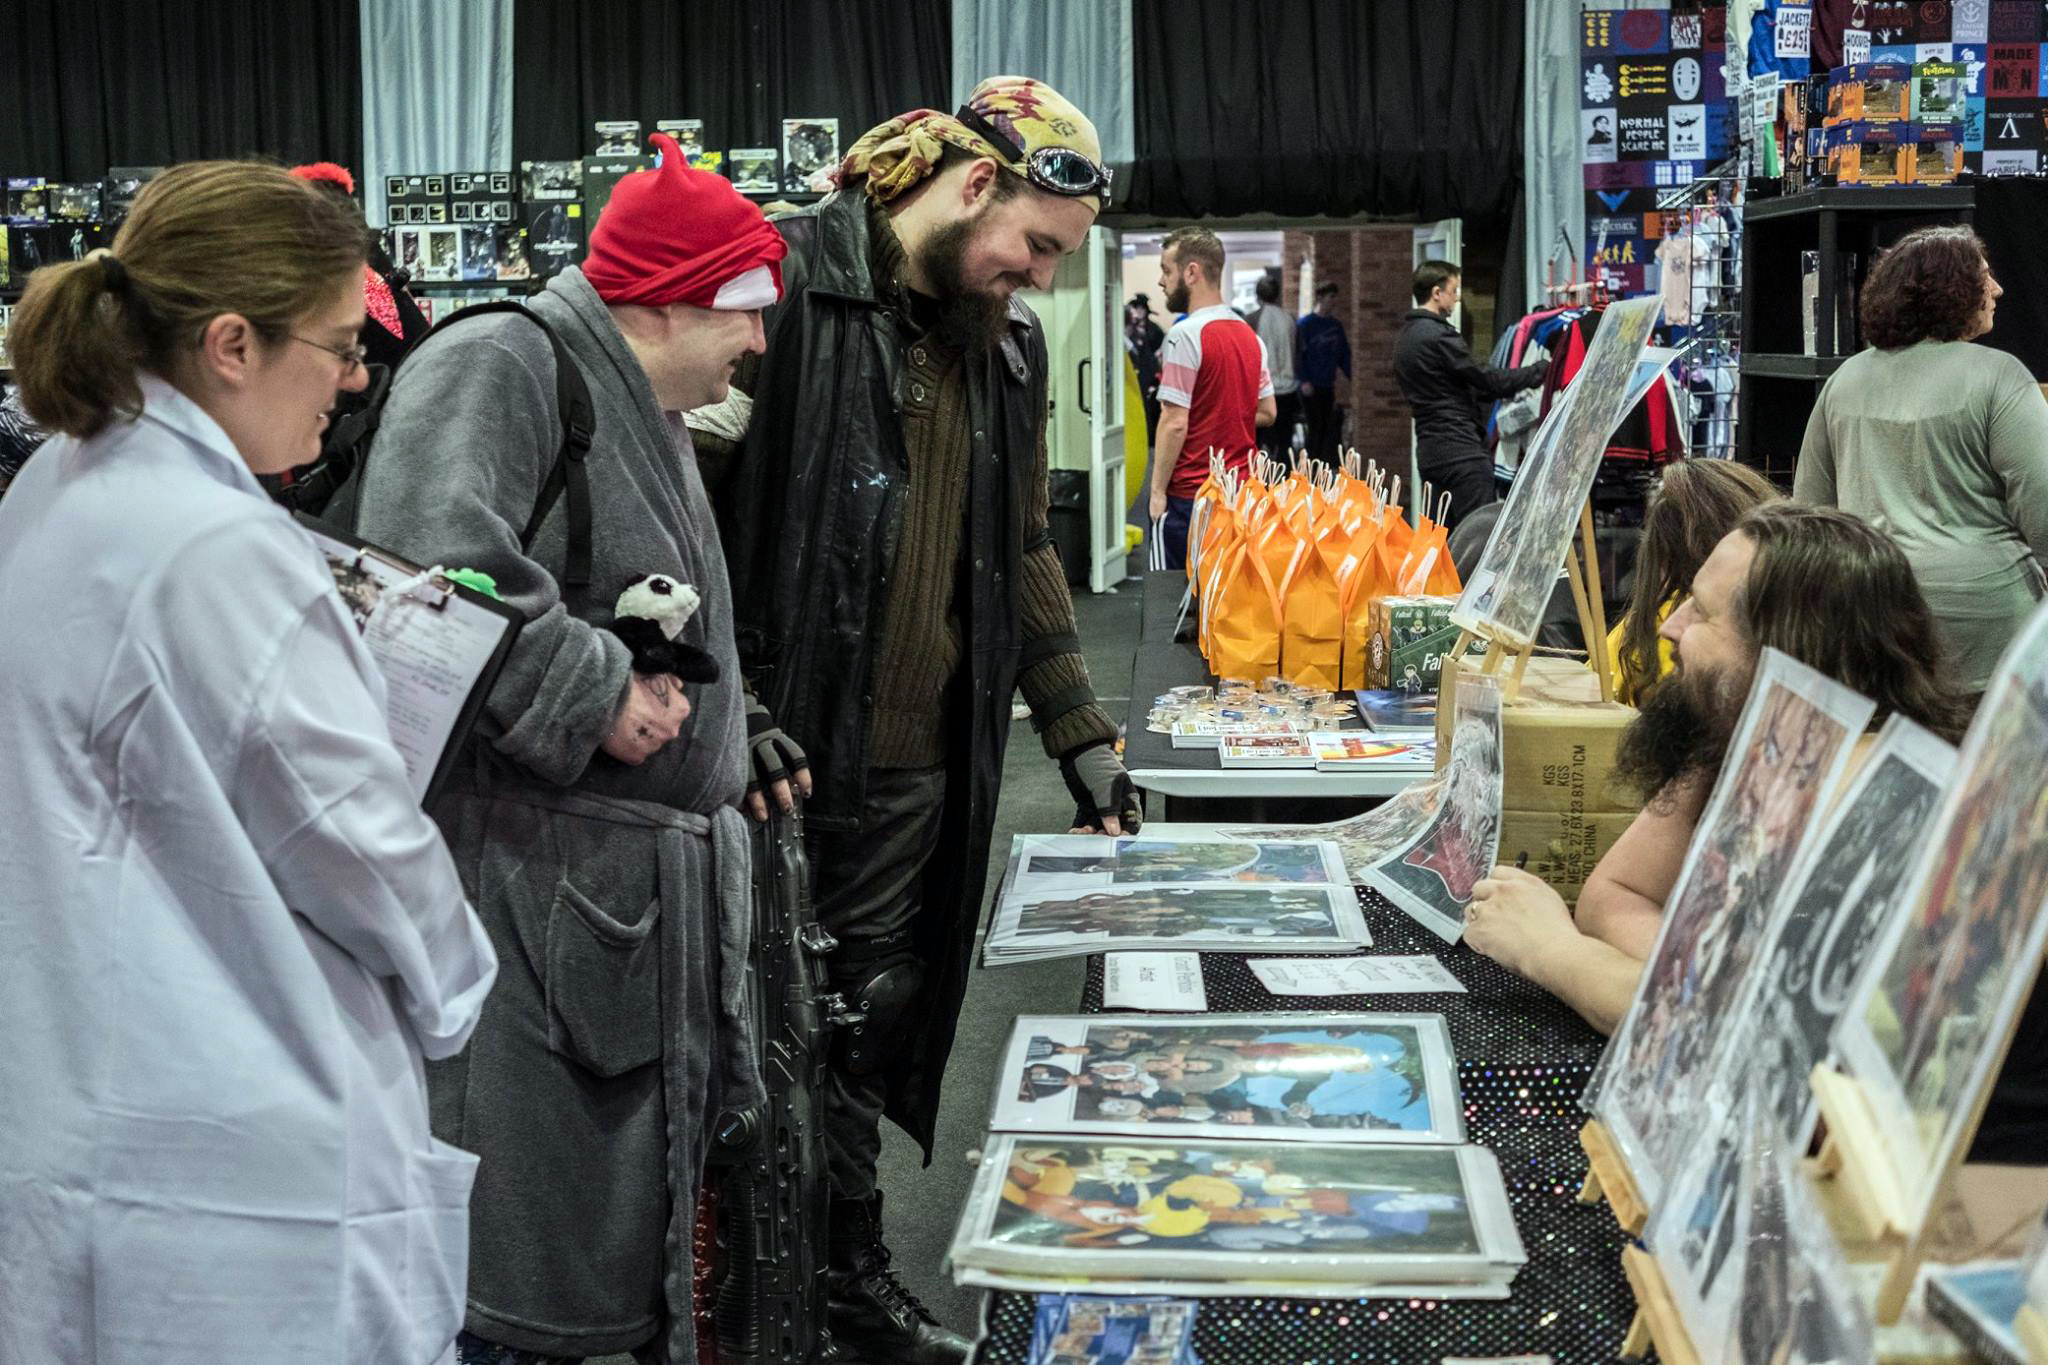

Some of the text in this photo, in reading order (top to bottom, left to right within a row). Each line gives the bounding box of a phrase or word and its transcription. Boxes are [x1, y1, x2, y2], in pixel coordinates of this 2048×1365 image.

[1779, 12, 1810, 27] JACKETS
[1784, 30, 1804, 49] £25
[1994, 48, 2034, 60] MADE
[1619, 117, 1666, 130] NORMAL
[1625, 129, 1660, 140] PEOPLE
[1621, 141, 1649, 152] SCARE
[1651, 140, 1666, 151] ME
[1543, 764, 1556, 785] KGS
[1557, 765, 1569, 786] KGS
[1583, 824, 1596, 856] CHINA
